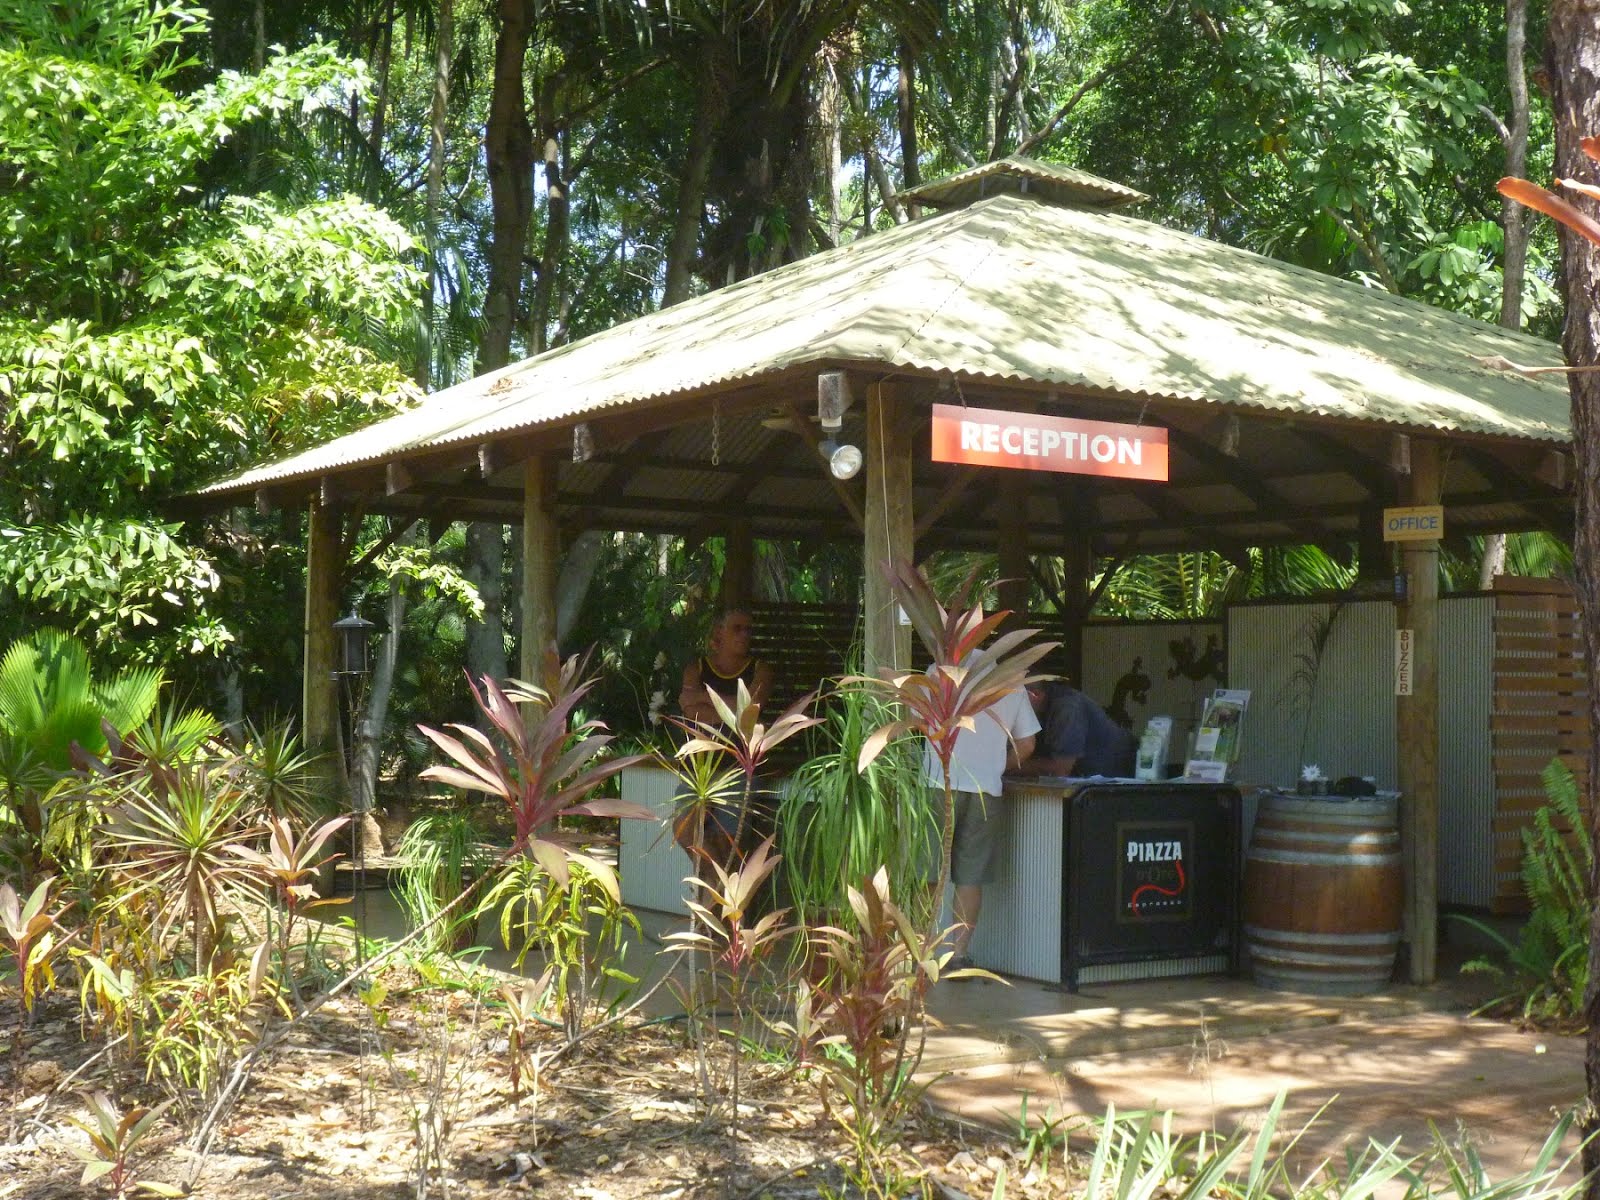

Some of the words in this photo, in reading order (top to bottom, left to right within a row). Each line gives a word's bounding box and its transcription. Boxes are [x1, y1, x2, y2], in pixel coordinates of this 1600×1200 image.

[960, 420, 1142, 465] RECEPTION
[1388, 516, 1439, 531] OFFICE
[1399, 631, 1410, 693] BUZZER
[1127, 841, 1182, 863] PIAZZA
